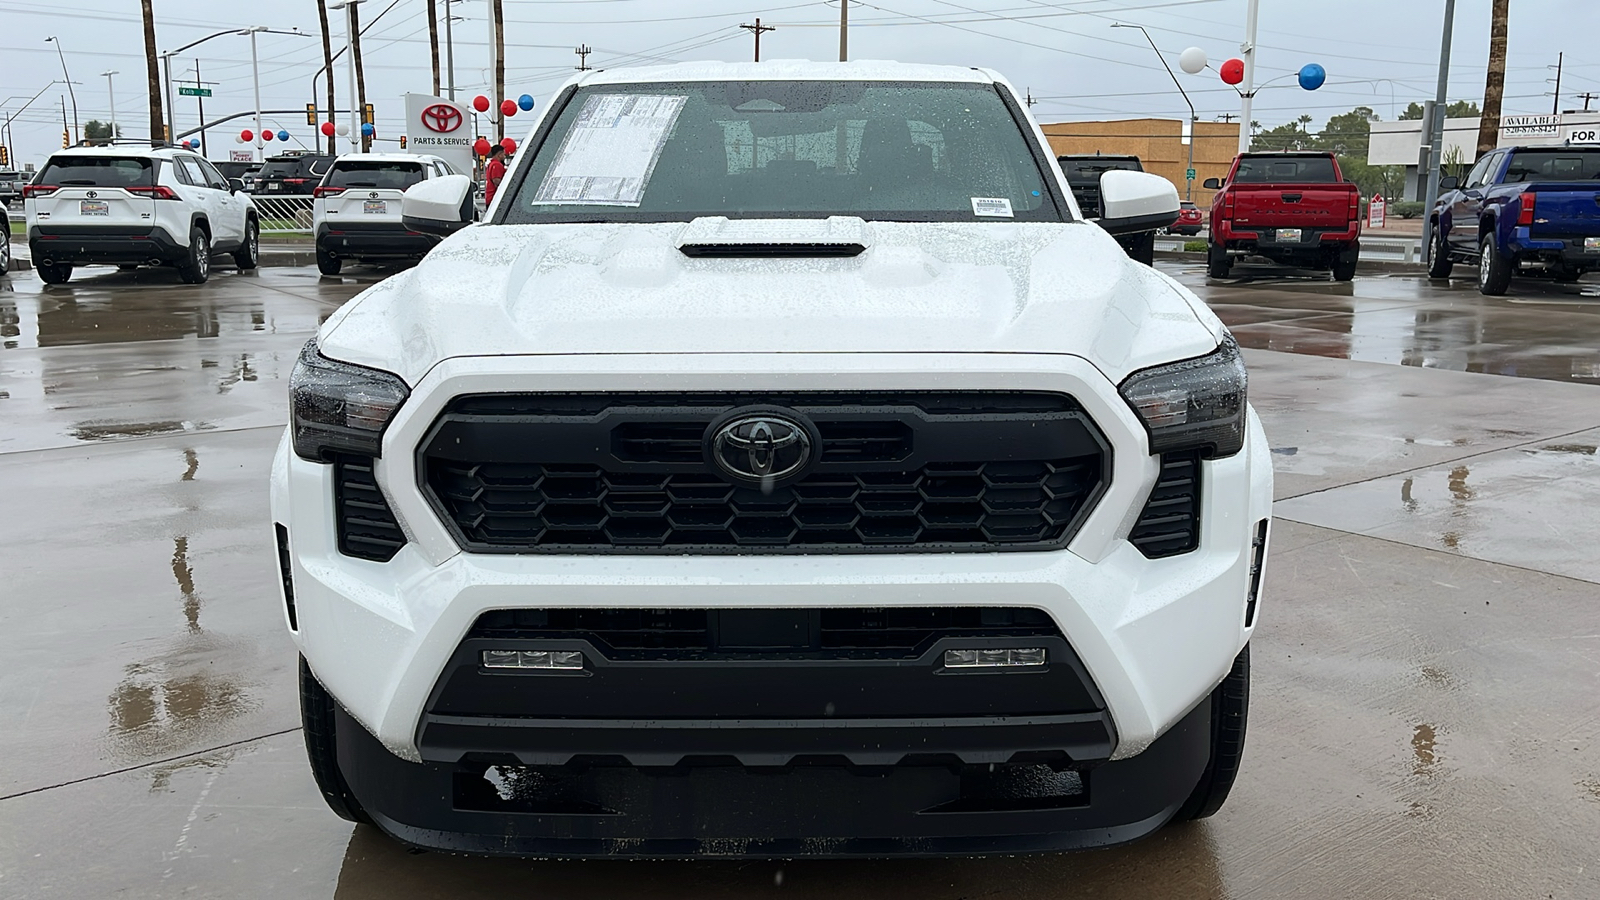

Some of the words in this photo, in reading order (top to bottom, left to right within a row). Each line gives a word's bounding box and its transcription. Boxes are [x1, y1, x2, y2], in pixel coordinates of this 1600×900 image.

[1505, 116, 1559, 125] AVAILABLE
[1571, 131, 1595, 141] FOR
[413, 137, 436, 145] PARTS
[436, 137, 442, 145] &
[443, 137, 470, 146] SERVICE
